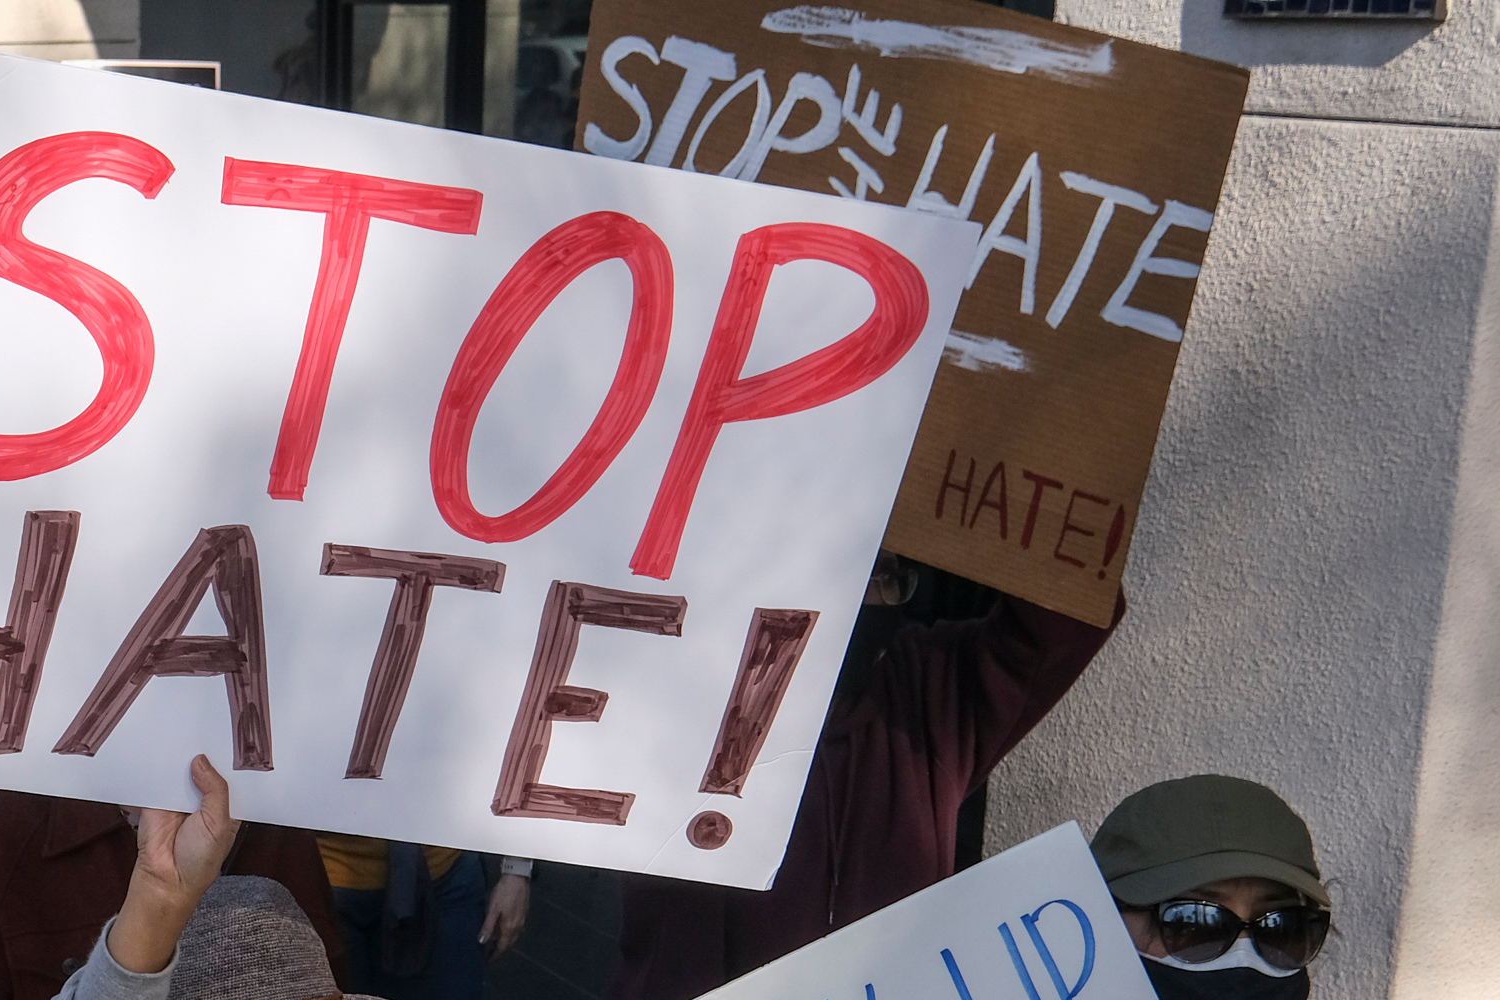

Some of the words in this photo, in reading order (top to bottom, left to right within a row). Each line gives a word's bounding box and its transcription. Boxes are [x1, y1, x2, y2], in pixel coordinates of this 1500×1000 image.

[583, 35, 844, 181] STOP
[906, 124, 1214, 342] HATE
[935, 449, 1126, 580] HATE!
